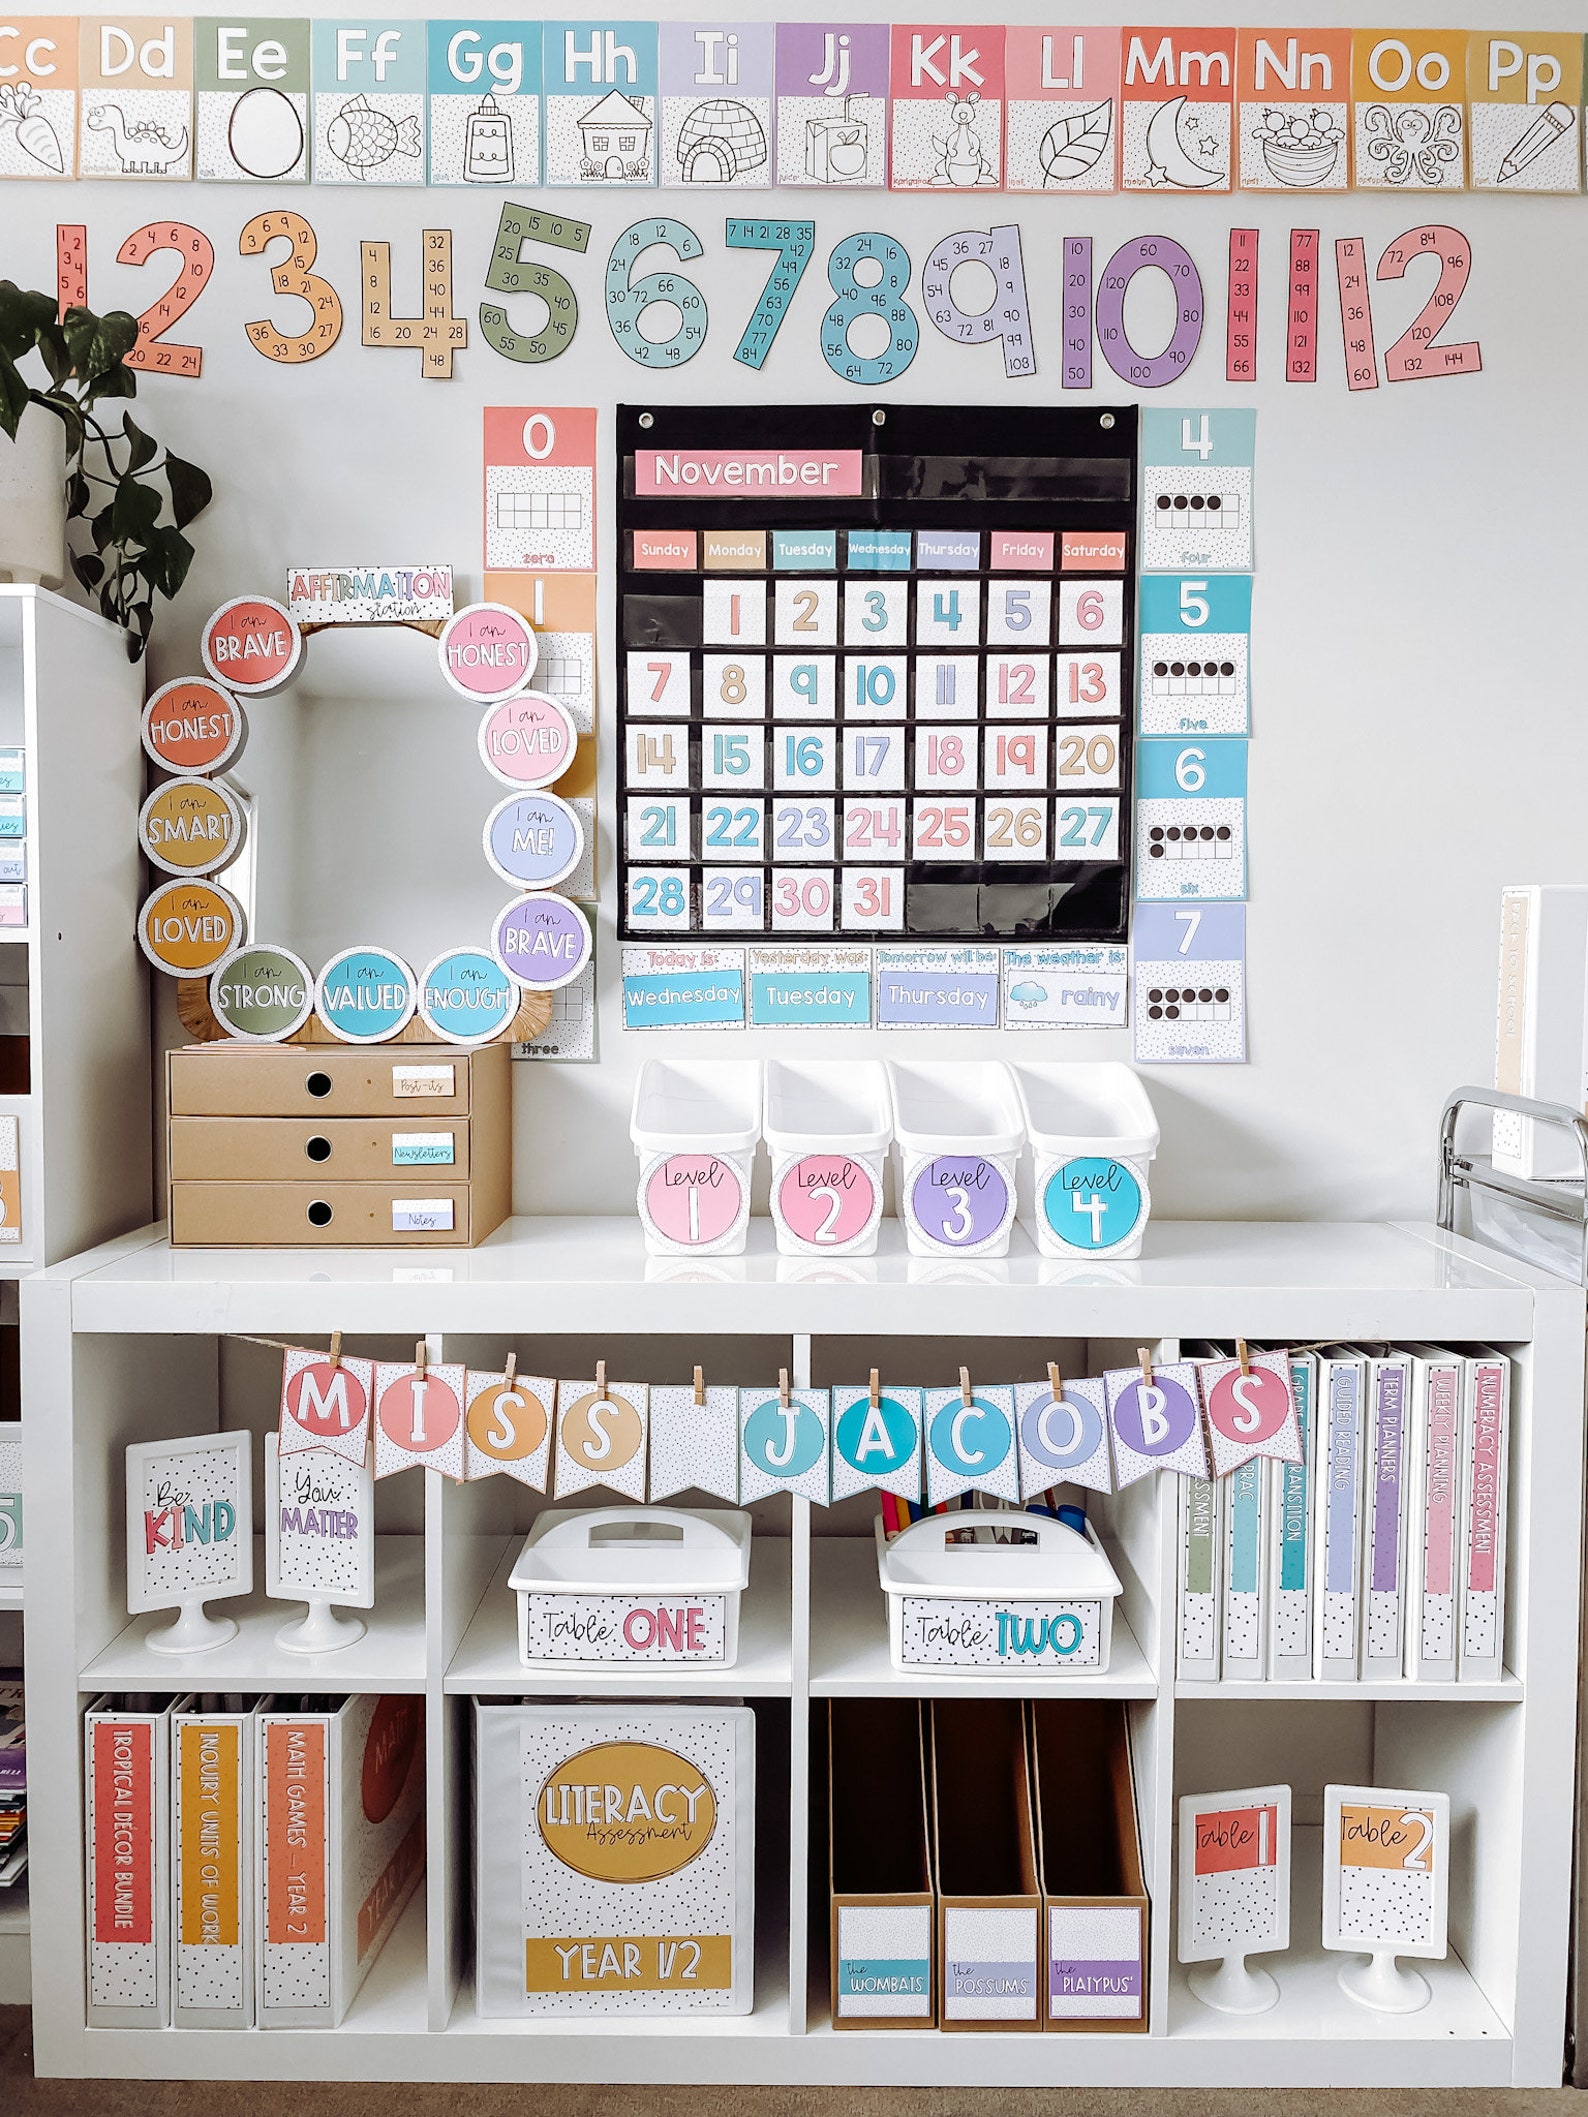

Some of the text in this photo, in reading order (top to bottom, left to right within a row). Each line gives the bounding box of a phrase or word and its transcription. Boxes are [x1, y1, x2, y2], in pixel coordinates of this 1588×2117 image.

[101, 25, 173, 78] Dd
[217, 27, 288, 81] Ee
[447, 30, 523, 95] Gg
[565, 31, 637, 84] Hh
[910, 34, 985, 89] Kk
[1125, 35, 1230, 87] Mm
[1255, 37, 1333, 92] Nn
[1368, 39, 1450, 91] Oo
[1488, 41, 1562, 104] Pp
[429, 236, 445, 249] 32
[1420, 232, 1436, 246] 84
[239, 210, 343, 364] 3
[480, 200, 592, 364] 5
[533, 272, 550, 286] 35
[658, 279, 674, 292] 66
[725, 217, 815, 371] 7
[1069, 274, 1085, 287] 20
[361, 228, 468, 379] 4
[820, 231, 920, 386] 8
[1335, 223, 1484, 392] 12
[252, 328, 269, 341] 36
[273, 343, 288, 356] 33
[529, 342, 547, 355] 50
[156, 353, 171, 366] 22
[877, 362, 893, 375] 72
[1009, 358, 1030, 370] 108
[1130, 366, 1152, 379] 100
[1292, 361, 1310, 374] 132
[1445, 353, 1463, 366] 144
[522, 413, 556, 460] 0
[1181, 415, 1214, 460] 4
[654, 453, 839, 488] November
[522, 553, 555, 564] zero
[641, 541, 689, 562] Sunday
[708, 542, 761, 562] Monday
[778, 542, 833, 562] Tuesday
[848, 543, 911, 557] Wednesday
[918, 541, 979, 561] Thursday
[1001, 541, 1045, 561] Friday
[1062, 542, 1125, 561] Saturday
[291, 571, 451, 602] AFFIRMATION
[366, 601, 422, 622] station
[1179, 581, 1209, 627] 5
[240, 616, 267, 629] am
[214, 631, 286, 663] BRAVE
[448, 641, 528, 669] HONEST
[720, 664, 748, 705] 8
[857, 665, 896, 706] 10
[1069, 663, 1107, 704] 13
[150, 712, 232, 744] HONEST
[492, 727, 563, 756] LOVED
[637, 734, 676, 775] 14
[713, 734, 751, 776] 15
[1059, 735, 1117, 776] 20
[1175, 747, 1206, 791] 6
[148, 813, 231, 844] SMART
[512, 828, 554, 857] ME!
[706, 807, 760, 847] 22
[917, 807, 971, 847] 25
[1060, 807, 1113, 847] 27
[632, 876, 686, 917] 28
[706, 877, 762, 916] 29
[774, 878, 830, 917] 30
[154, 915, 227, 944] LOVED
[505, 928, 576, 961] BRAVE
[1174, 911, 1202, 955] 7
[357, 966, 385, 978] am
[647, 951, 696, 968] Today
[752, 950, 868, 965] Yesterday was:
[878, 950, 997, 963] Tomorrow will be:
[1004, 951, 1032, 966] The
[1037, 950, 1104, 965] weather
[218, 983, 305, 1011] STRONG
[322, 984, 406, 1011] VALUED
[425, 984, 510, 1011] ENOUGH
[627, 985, 741, 1007] Wednesday
[766, 986, 855, 1009] Tuesday
[887, 985, 989, 1010] Thursday
[1061, 987, 1120, 1011] rainy
[400, 1079, 444, 1093] Post-its
[394, 1146, 451, 1160] Newsletters
[664, 1162, 725, 1190] Level
[798, 1162, 858, 1190] Level
[930, 1162, 991, 1191] Level
[1062, 1164, 1123, 1192] Level
[408, 1213, 436, 1227] Notes
[808, 1187, 842, 1242] 2
[942, 1187, 974, 1242] 3
[1070, 1190, 1108, 1243] 4
[297, 1370, 620, 1461] MISS
[765, 1375, 1264, 1467] JACOBS
[1334, 1377, 1353, 1491] GUIDED READING
[1380, 1377, 1399, 1482] TERM PLANNERS
[1432, 1378, 1451, 1504] WEEKLY PLANNING
[1474, 1375, 1497, 1556] NUMERACY ASSESSMENT
[156, 1481, 193, 1508] Be
[295, 1471, 342, 1505] You
[1238, 1465, 1255, 1502] PRAC
[144, 1500, 236, 1555] KIND
[281, 1505, 359, 1541] MATTER
[544, 1607, 706, 1652] Table ONE
[917, 1612, 1084, 1656] Table TWO
[113, 1730, 133, 1806] TROPICAL
[544, 1783, 708, 1826] LITERACY
[200, 1732, 220, 1945] INQUIRY UNITS OF WORK
[286, 1731, 307, 1935] MATH GAMES YEAR 2
[586, 1822, 693, 1846] Assessment
[1194, 1813, 1255, 1851] Table
[1341, 1811, 1434, 1869] Table 2
[114, 1873, 134, 1928] BUNDLE
[554, 1940, 701, 1980] YEAR 1/2
[846, 1962, 868, 1975] the
[952, 1963, 974, 1976] the
[1055, 1962, 1076, 1975] the
[850, 1976, 924, 1993] WOMBATS
[955, 1978, 1029, 1994] POSSUMS
